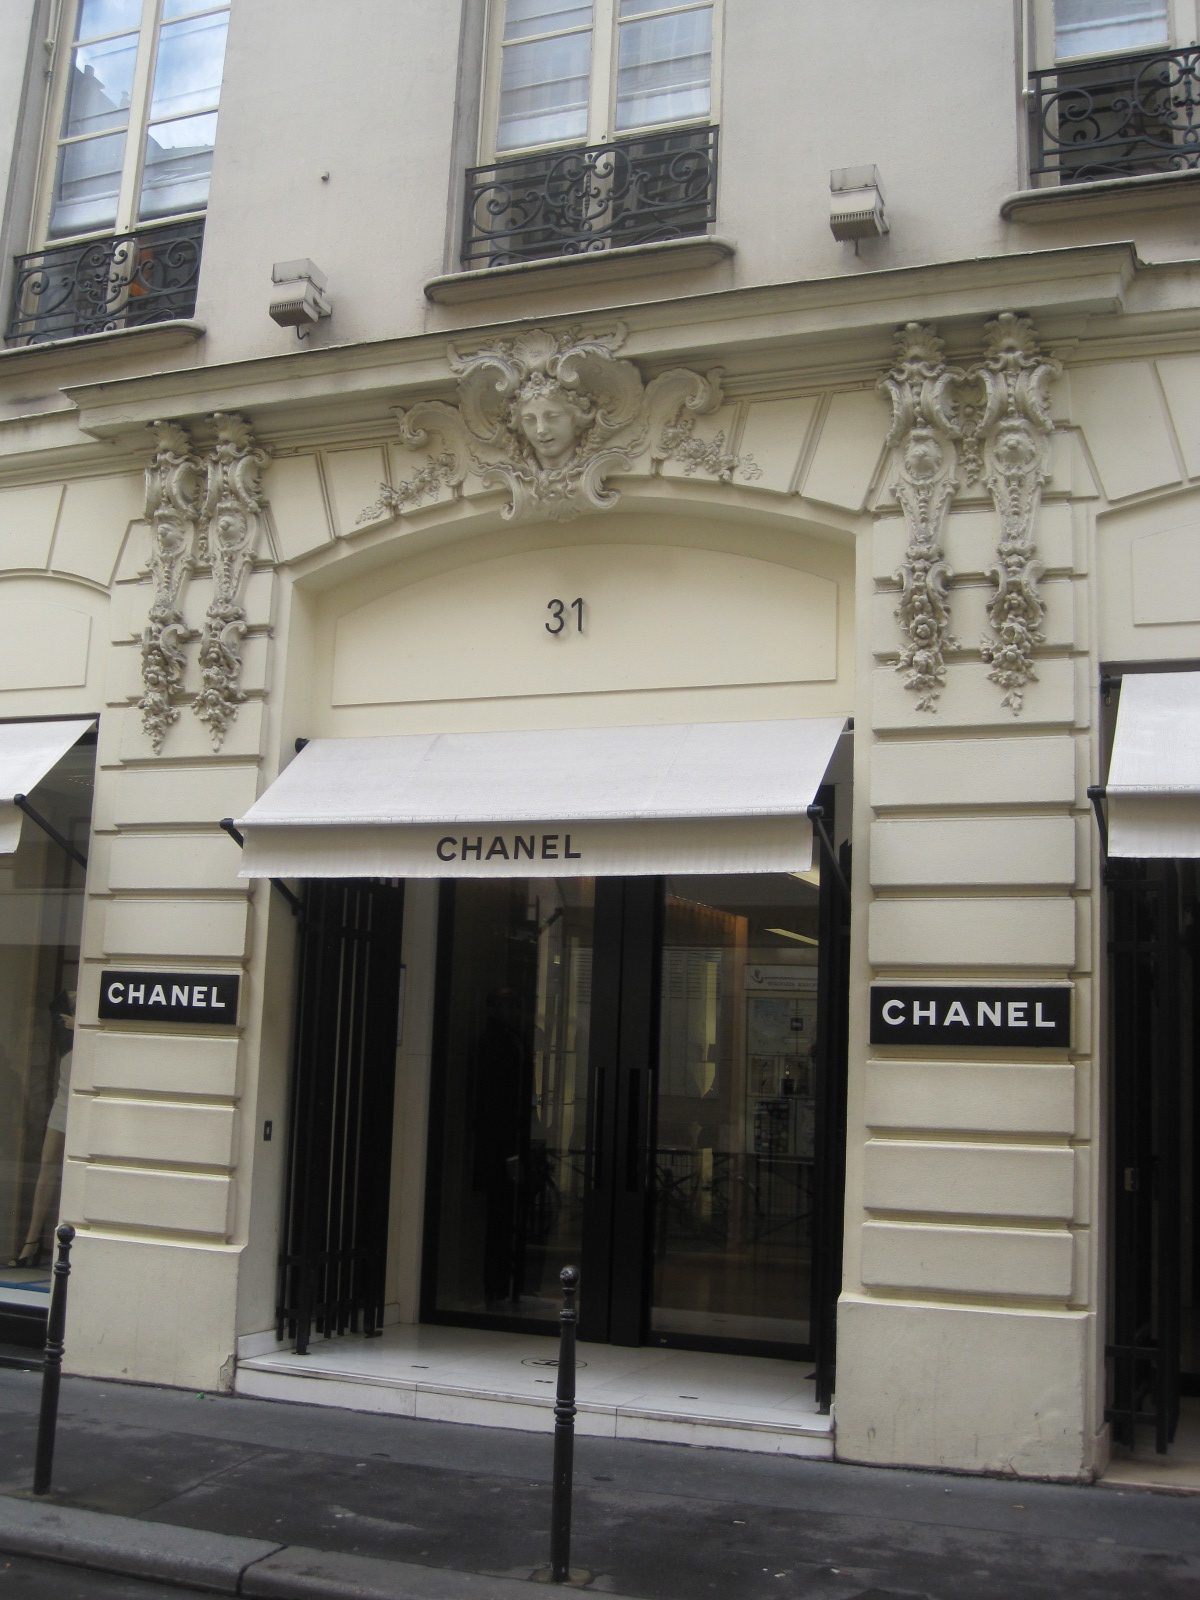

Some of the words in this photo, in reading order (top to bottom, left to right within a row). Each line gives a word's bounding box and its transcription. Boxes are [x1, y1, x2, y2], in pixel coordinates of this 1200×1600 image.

[545, 597, 584, 634] 31
[436, 834, 582, 862] CHANEL
[107, 982, 226, 1009] CHANEL
[881, 999, 1056, 1028] CHANEL
